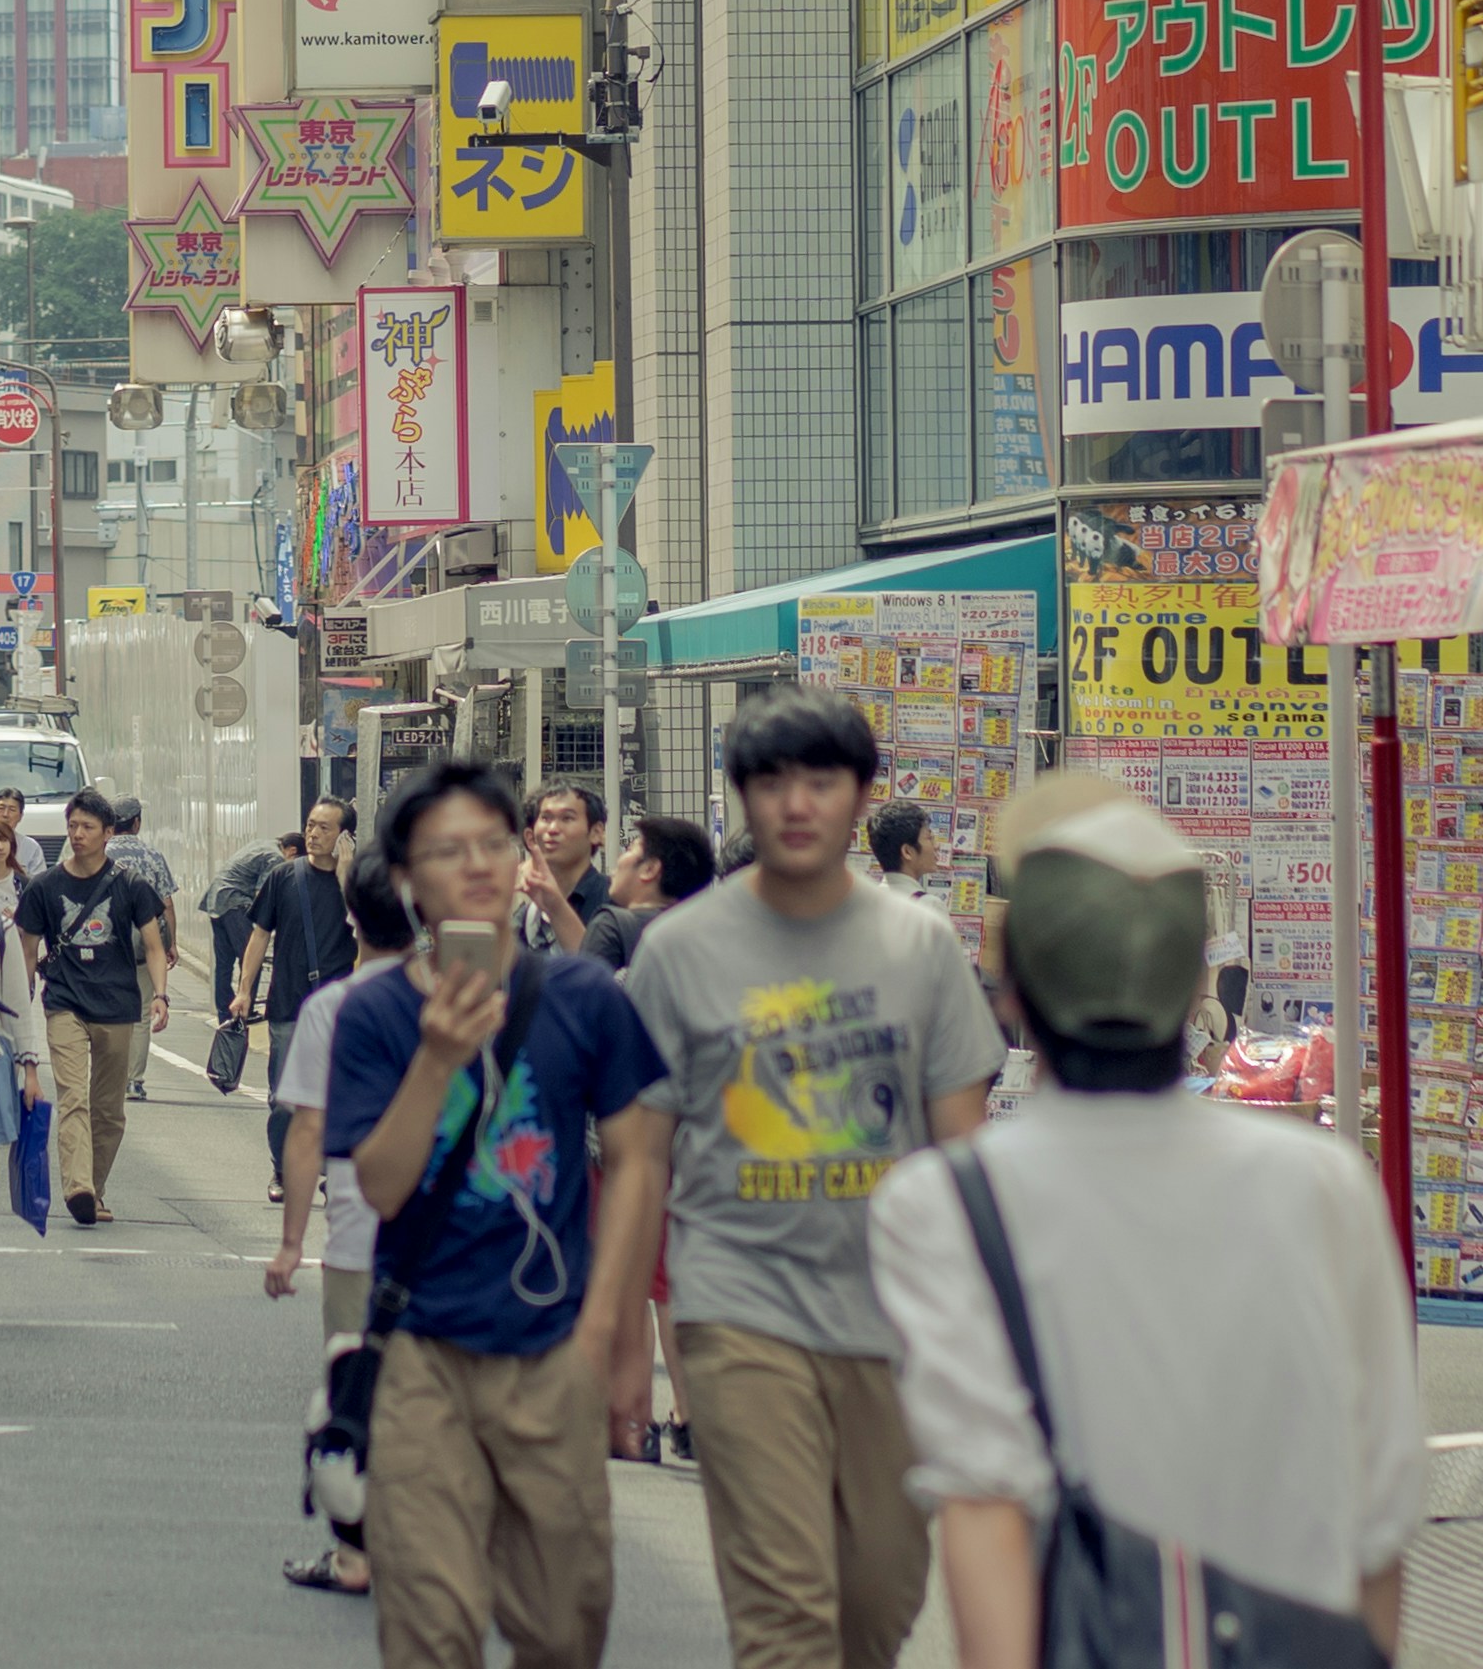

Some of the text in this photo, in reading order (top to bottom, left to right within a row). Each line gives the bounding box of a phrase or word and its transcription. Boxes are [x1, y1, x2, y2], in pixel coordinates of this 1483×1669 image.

[298, 118, 357, 146] 東京
[1104, 98, 1353, 194] OUTL
[265, 163, 387, 190] レジャーランド
[176, 231, 223, 254] 東京
[1142, 525, 1259, 551] 当店2F
[17, 576, 31, 587] 17
[882, 594, 933, 607] Windows
[1073, 610, 1208, 625] Welcome
[326, 645, 367, 656] (全台交
[1071, 626, 1329, 684] 2F OUTL
[1208, 698, 1329, 713] Bienve
[1226, 712, 1325, 723] selama
[1163, 723, 1325, 738] пожало
